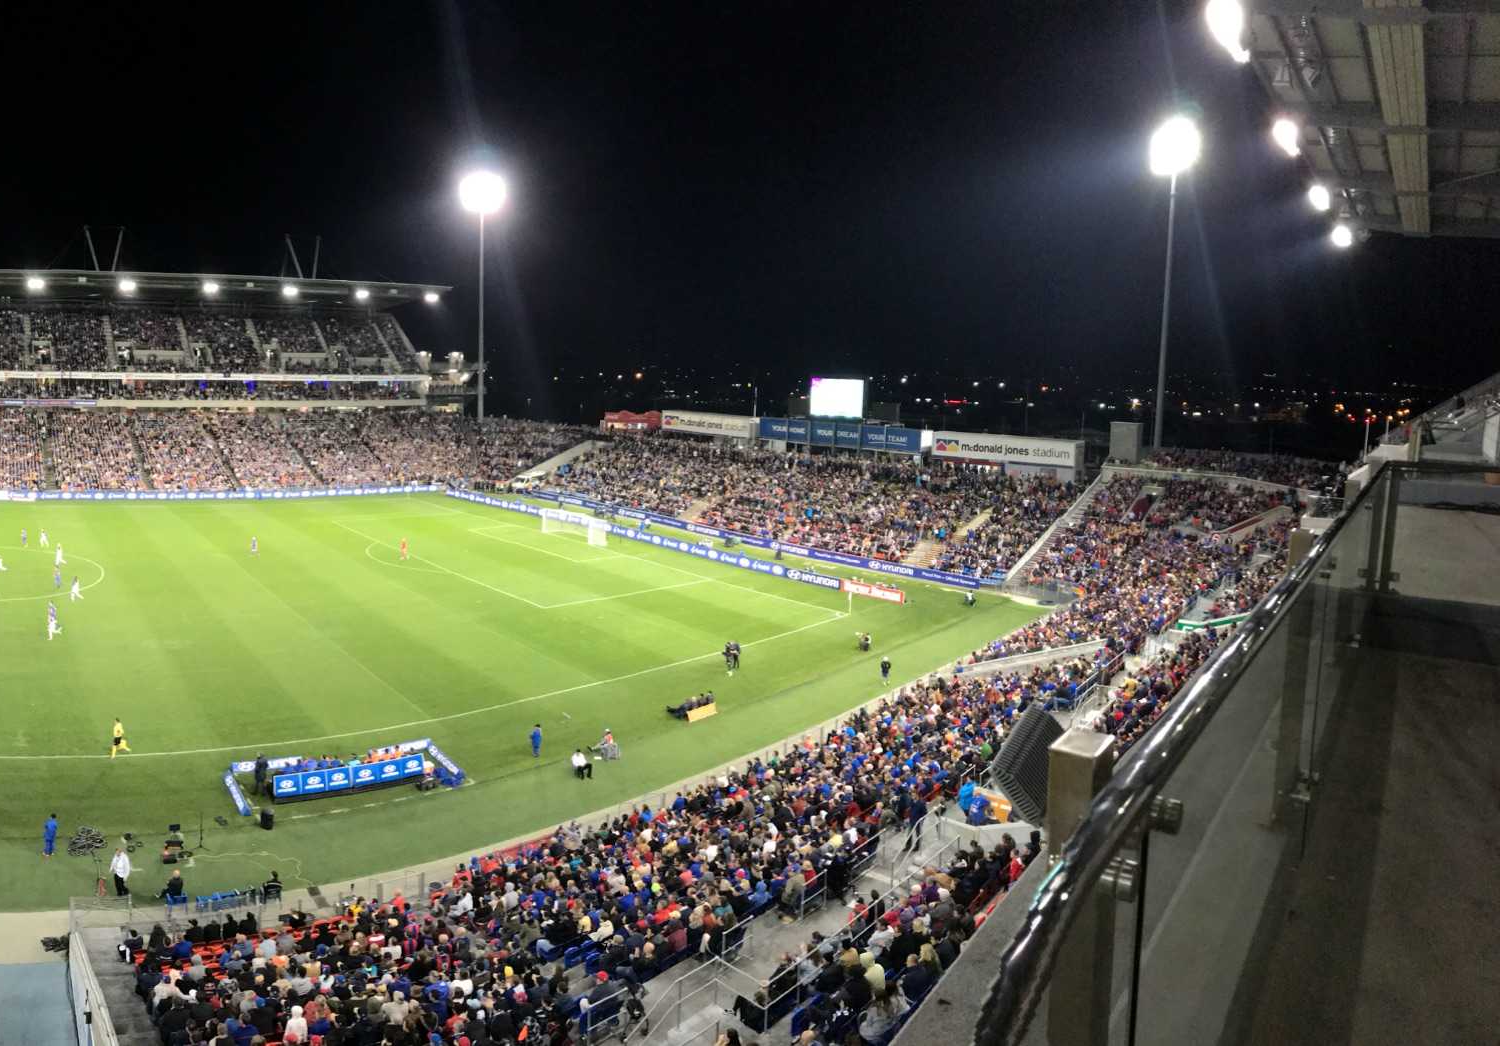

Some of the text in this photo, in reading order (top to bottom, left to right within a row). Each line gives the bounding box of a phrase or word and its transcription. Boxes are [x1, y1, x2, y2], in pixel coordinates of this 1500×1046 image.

[867, 433, 886, 442] YOUR
[960, 443, 1070, 460] mcdonald jones stadium
[881, 564, 914, 576] HYUNDAI
[801, 573, 840, 588] HYUNDAI
